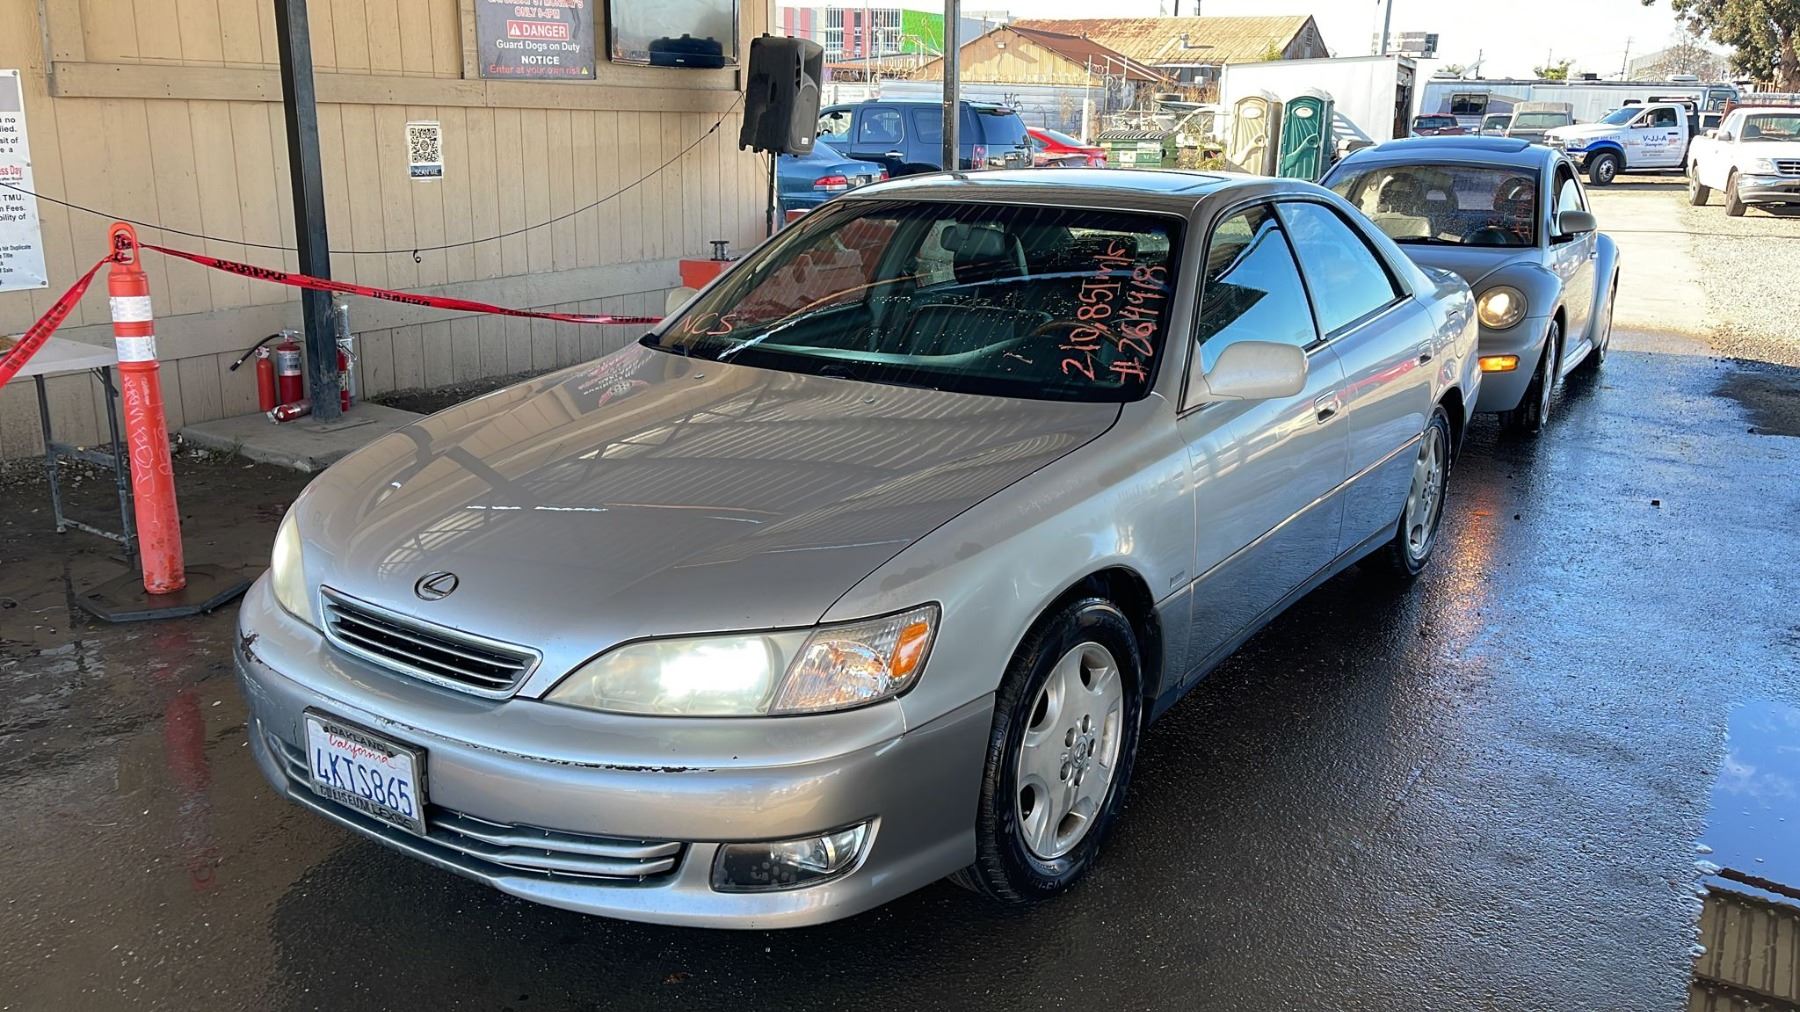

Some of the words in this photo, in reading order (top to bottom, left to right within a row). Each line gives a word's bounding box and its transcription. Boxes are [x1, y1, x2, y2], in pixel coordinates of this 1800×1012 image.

[523, 24, 566, 37] DANGER
[496, 39, 523, 49] Guard
[525, 41, 547, 52] Dogs
[562, 42, 580, 53] Duty
[521, 55, 560, 65] NOTICE
[490, 64, 513, 73] Enter
[515, 66, 524, 74] at
[526, 66, 545, 75] your
[11, 136, 18, 144] of
[10, 164, 22, 177] Day
[18, 213, 26, 221] of
[330, 726, 386, 752] OAKLAND
[329, 734, 396, 769] California
[316, 748, 413, 817] 4KTS865
